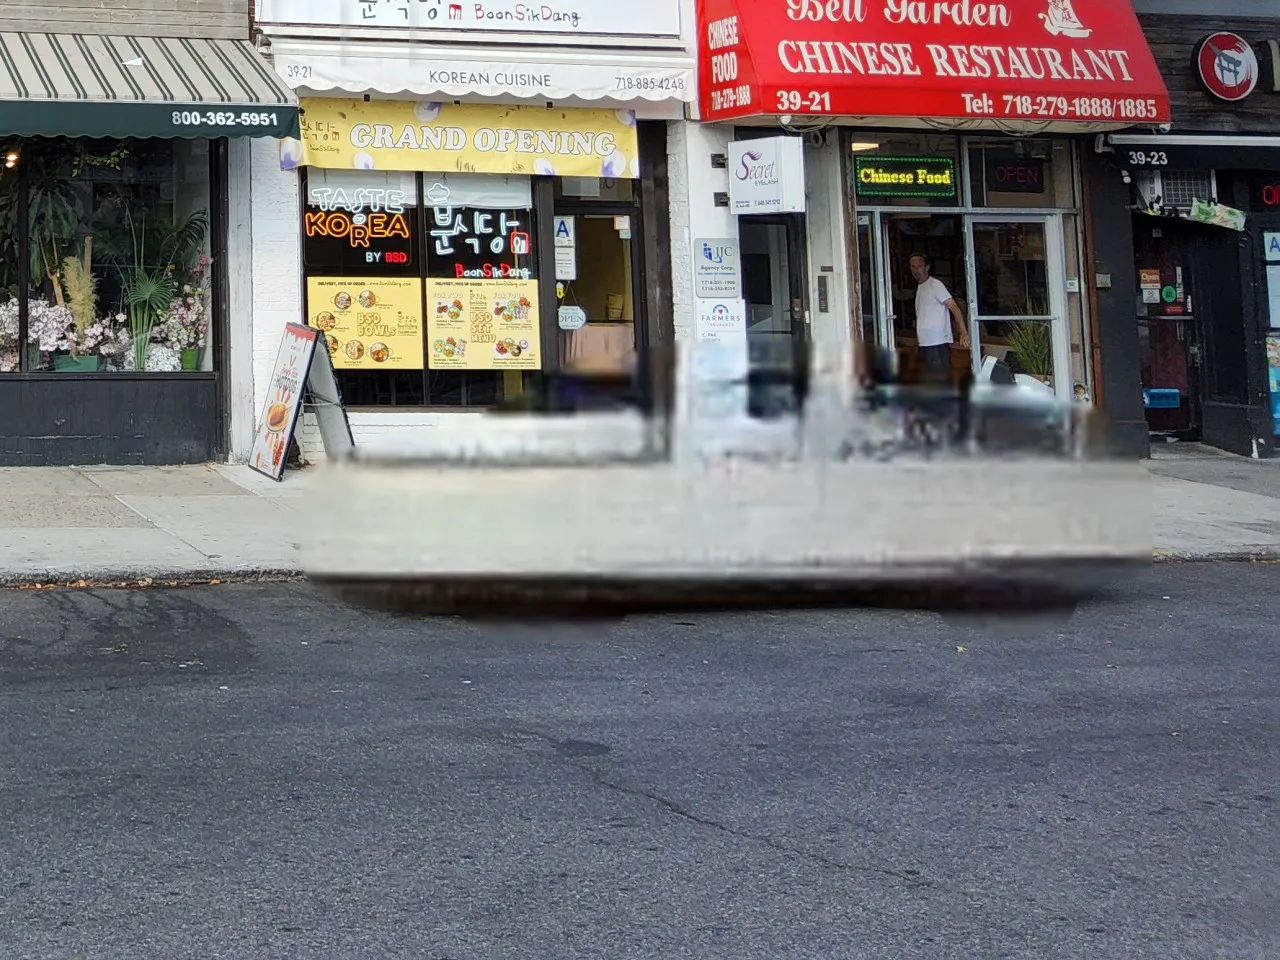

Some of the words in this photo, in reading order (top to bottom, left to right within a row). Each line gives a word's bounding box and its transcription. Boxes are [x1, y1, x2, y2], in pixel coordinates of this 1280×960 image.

[474, 3, 582, 28] BoonSikDang
[708, 15, 739, 51] CHINESE
[711, 51, 738, 84] FOOD
[777, 39, 922, 76] CHINESE
[925, 43, 1134, 82] RESTAURANT
[286, 65, 313, 80] 39-21
[429, 70, 490, 85] KOREAN
[494, 72, 552, 87] CUISINE
[615, 76, 685, 91] 718-885-4248
[711, 85, 752, 112] 718-279-1888
[776, 91, 832, 112] 39-21
[961, 92, 994, 115] Tel:
[1002, 94, 1158, 119] 718-279-1888/1885
[171, 109, 279, 127] 800-362-5951
[349, 122, 467, 152] GRAND
[473, 126, 617, 157] OPENING
[735, 150, 776, 181] Secret
[1129, 151, 1169, 166] 39-23
[860, 168, 914, 184] Chinese
[916, 169, 951, 185] Food
[995, 165, 1038, 183] OPEN
[311, 187, 404, 214] TASTE
[305, 212, 410, 248] KOREA
[555, 220, 570, 238] A
[365, 252, 381, 263] BY
[385, 251, 408, 263] BSD
[455, 262, 532, 280] BoonSikDang
[1140, 272, 1160, 282] Open
[357, 312, 381, 325] BSD
[469, 311, 493, 323] BSD
[470, 323, 493, 334] SET
[470, 333, 497, 344] MENU
